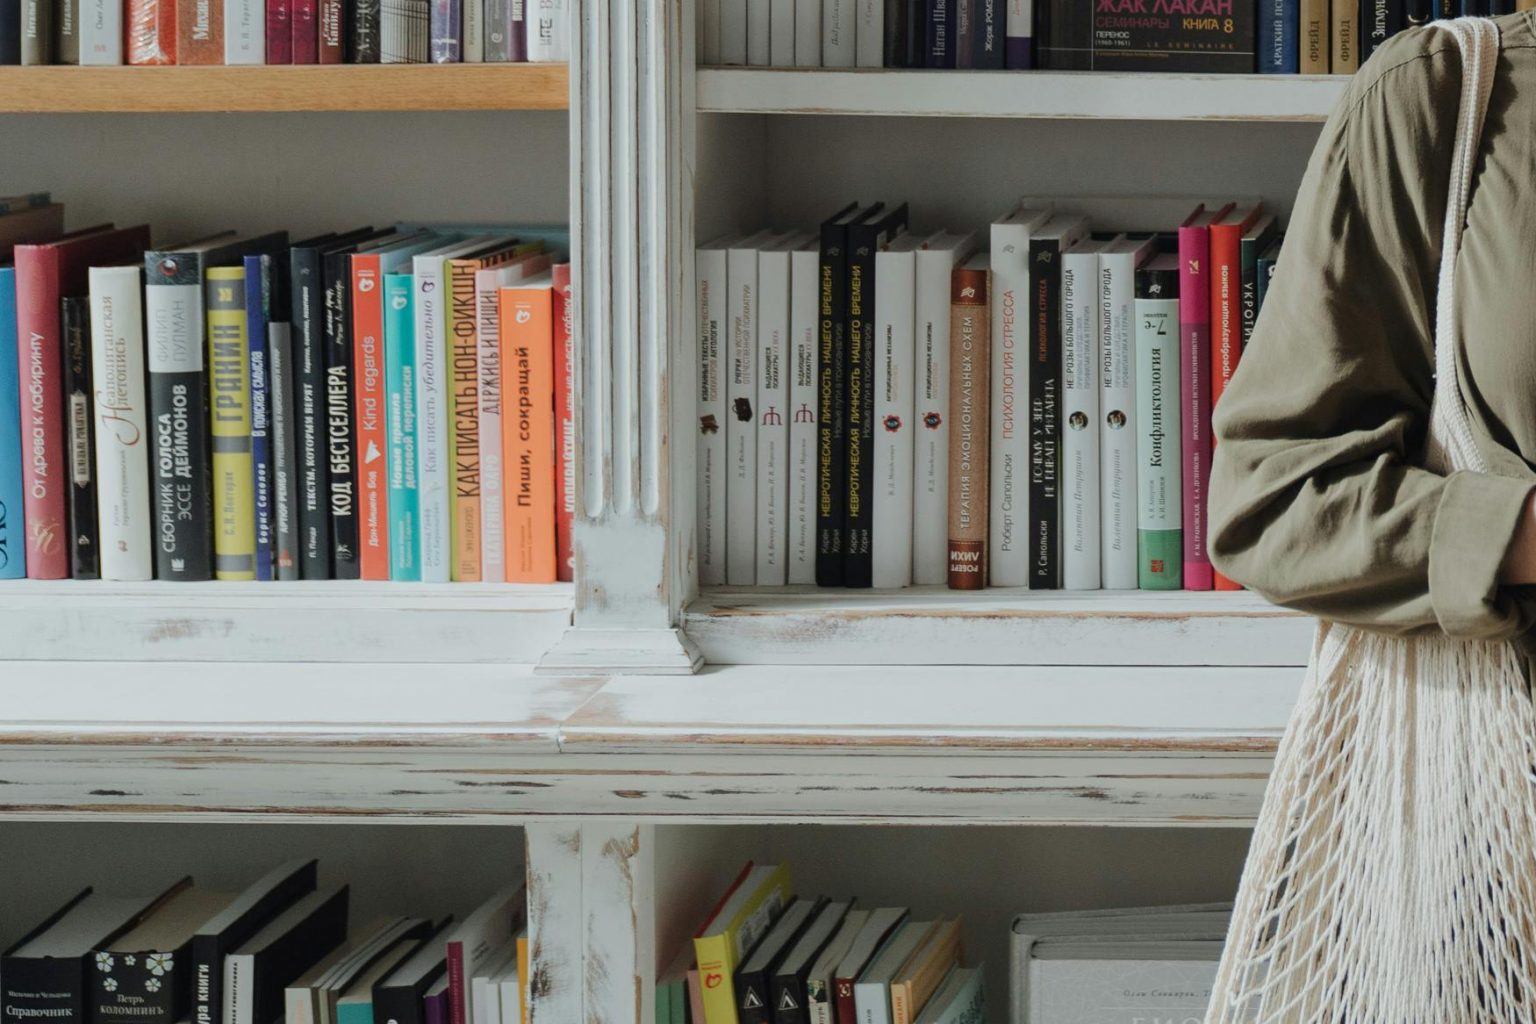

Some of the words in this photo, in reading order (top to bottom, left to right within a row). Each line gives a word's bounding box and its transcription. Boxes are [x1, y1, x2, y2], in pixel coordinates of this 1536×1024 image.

[1096, 15, 1169, 29] СЕМИНАРЫ
[1183, 19, 1219, 30] КНИГА
[1224, 20, 1233, 33] 8
[1274, 20, 1283, 65] КРАТКИЙ
[1308, 20, 1320, 62] ФРЕЙД
[822, 266, 833, 315] ВРЕМЕНИ
[451, 264, 478, 382] НОН-ФИКШН
[822, 320, 832, 363] НАШЕГО
[962, 316, 973, 351] СХЕМ
[1002, 290, 1015, 349] СТРЕССА
[29, 332, 46, 414] лабиринту
[212, 324, 243, 422] ГРАНИН
[362, 336, 377, 392] regards
[34, 416, 44, 425] к
[327, 365, 351, 473] БЕСТСЕЛЛЕРА
[363, 398, 377, 431] Kind
[455, 387, 480, 456] ПИСАТЬ
[515, 347, 530, 441] сокращай
[821, 367, 832, 424] ЛИЧНОСТЬ
[961, 356, 973, 471] ЭМОЦИОНАЛЬНЫХ
[1002, 352, 1015, 440] ПСИХОЛОГИЯ
[1149, 348, 1164, 468] Конфликтология
[32, 428, 48, 476] древа
[157, 414, 173, 478] ГОЛОСА
[172, 384, 192, 478] ДЕЙМОНОВ
[32, 479, 46, 498] От
[331, 482, 352, 516] КОД
[456, 459, 480, 497] КАК
[516, 450, 532, 507] Пиши,
[821, 428, 832, 517] НЕВРОТИЧЕСКАЯ
[1001, 454, 1014, 511] Сапольски
[162, 483, 177, 553] СБОРНИК
[177, 483, 193, 521] ЭССЕ
[960, 475, 970, 528] ТЕРАПИЯ
[1001, 514, 1013, 551] Роберт
[6, 1005, 73, 1019] Справочник
